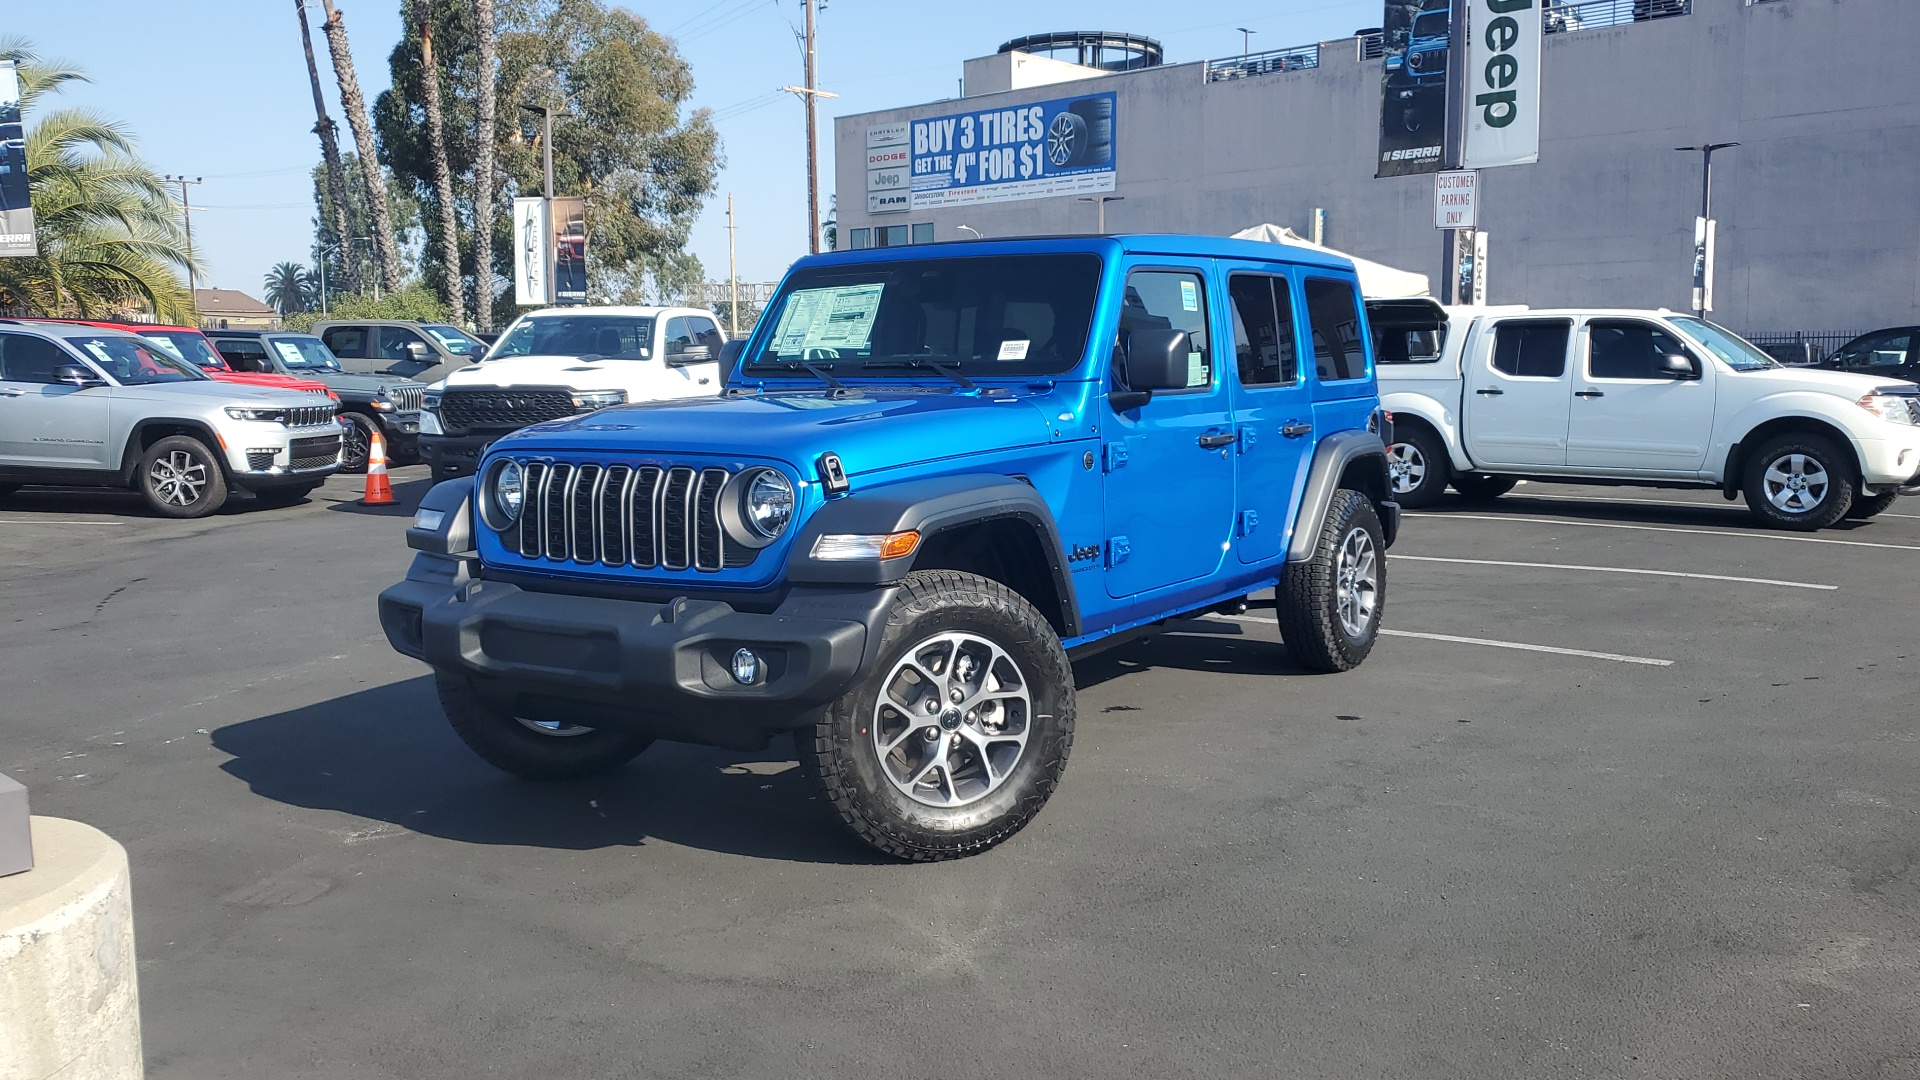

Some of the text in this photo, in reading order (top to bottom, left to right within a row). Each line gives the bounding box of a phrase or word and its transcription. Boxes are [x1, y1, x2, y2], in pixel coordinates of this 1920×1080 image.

[870, 127, 905, 136] CHRYSLER
[915, 106, 1043, 155] BUY 3 TIRES
[869, 152, 906, 163] DODGE
[1391, 146, 1441, 160] SIERRA
[915, 157, 933, 174] GET
[934, 155, 953, 172] THE
[954, 151, 976, 183] 4TH
[979, 147, 1015, 182] FOR
[1020, 142, 1043, 179] $1
[875, 172, 900, 186] Jeep
[1438, 175, 1474, 189] CUSTOMER
[948, 188, 978, 197] Firestone
[1441, 193, 1470, 206] PARKING
[880, 196, 907, 205] RAM
[1446, 211, 1463, 224] ONLY
[1475, 247, 1485, 300] Jeep
[1068, 543, 1100, 563] Jeep
